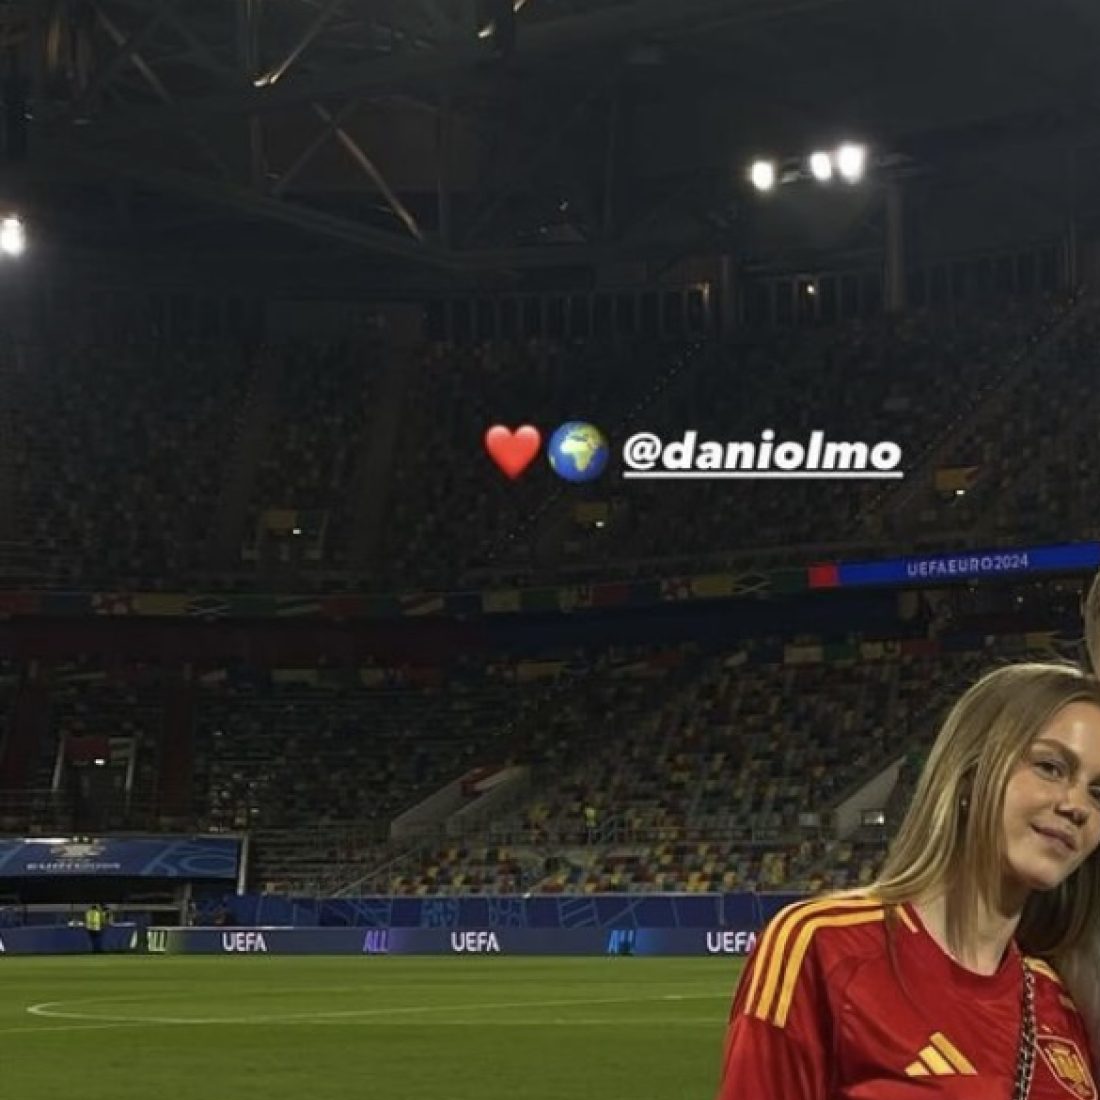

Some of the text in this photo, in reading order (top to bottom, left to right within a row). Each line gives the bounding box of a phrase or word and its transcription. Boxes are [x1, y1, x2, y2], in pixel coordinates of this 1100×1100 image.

[222, 932, 268, 951] UEFA
[363, 929, 388, 952] ALL
[450, 931, 500, 952] UEFA
